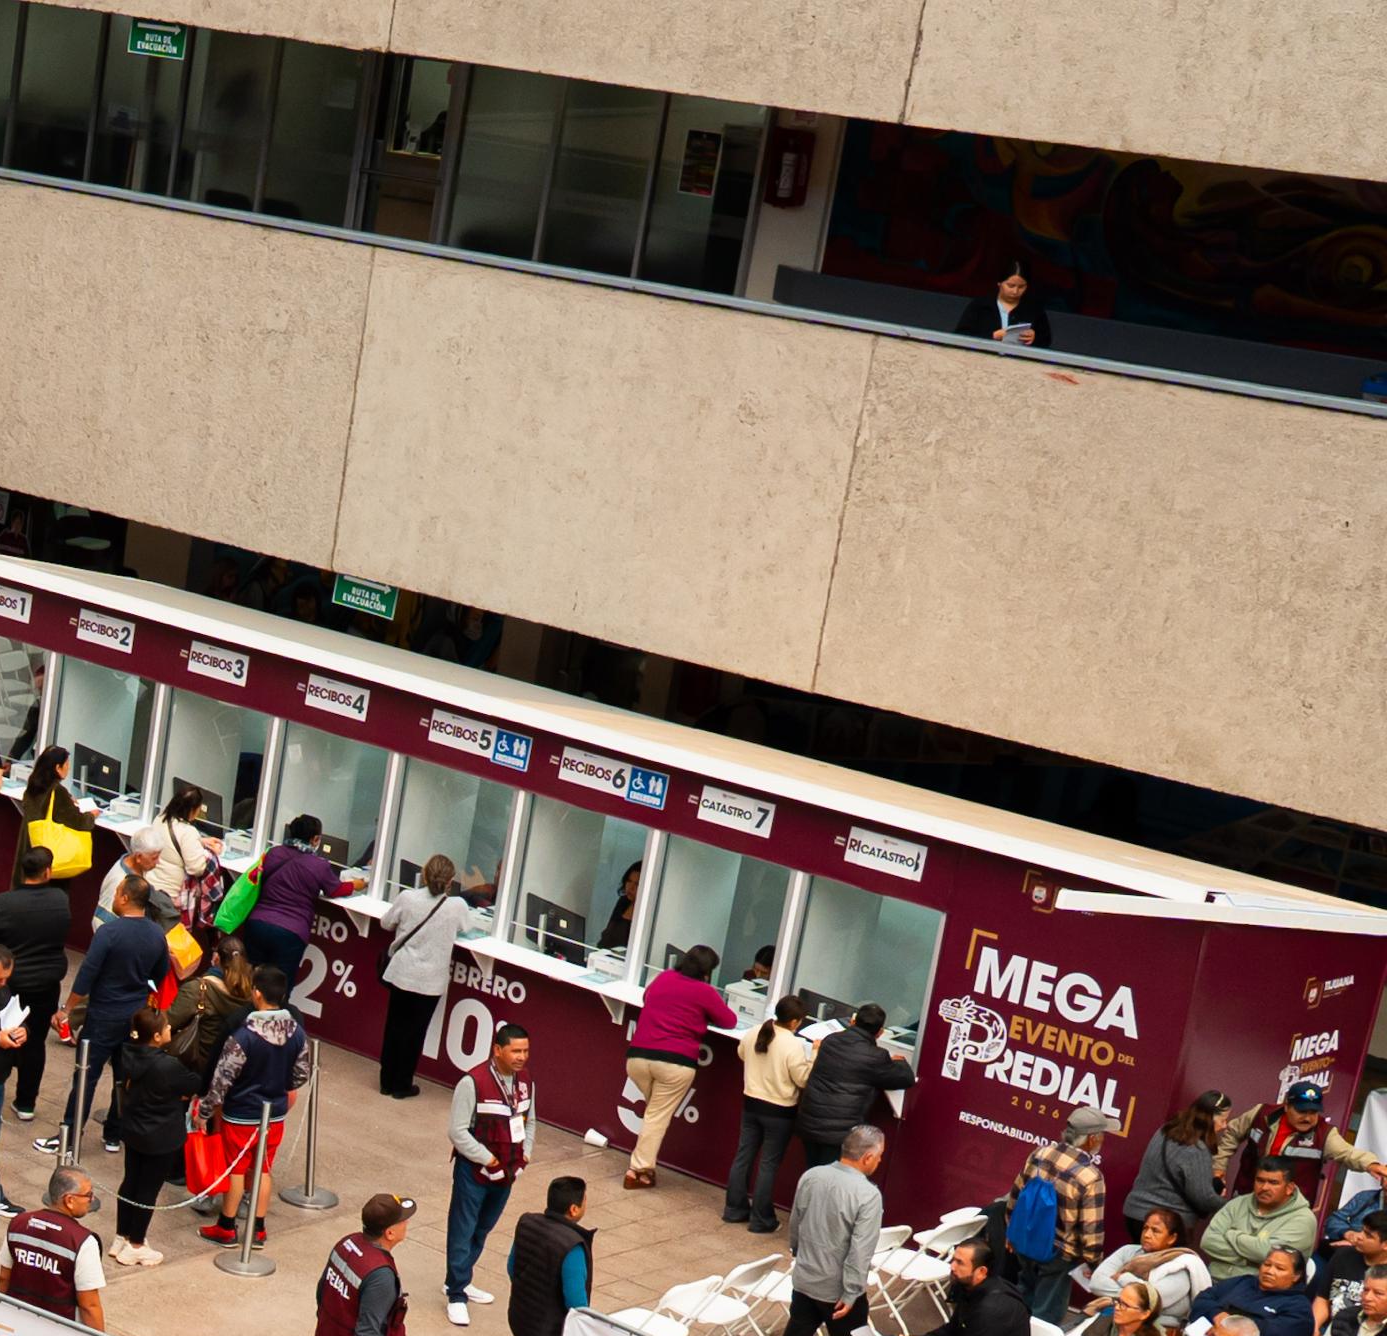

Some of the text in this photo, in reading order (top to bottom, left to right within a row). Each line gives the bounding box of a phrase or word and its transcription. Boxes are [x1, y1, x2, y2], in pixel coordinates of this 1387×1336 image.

[137, 41, 177, 54] EVACUACIÓN
[145, 33, 171, 44] RUTA DE
[20, 597, 27, 616] 1
[342, 592, 386, 612] EVACUACIÓN
[352, 587, 380, 601] RUTA DE
[80, 618, 131, 645] RECIBOS 2
[191, 649, 244, 679] RECIBOS 3
[308, 684, 365, 714] RECIBOS 4
[431, 719, 492, 751] RECIBOS 5
[562, 758, 626, 789] RECIBOS 6
[701, 798, 770, 829] CATASTRO 7
[448, 964, 526, 1003] EBRERO
[974, 946, 1138, 1039] MEGA
[1009, 1015, 1135, 1067] EVENTO DEL
[1291, 1030, 1339, 1062] MEGA
[939, 996, 1121, 1117] PREDIAL
[1300, 1058, 1330, 1076] EVENTO
[1010, 1095, 1060, 1119] 2026
[958, 1111, 1048, 1147] RESPONSABILIDAD
